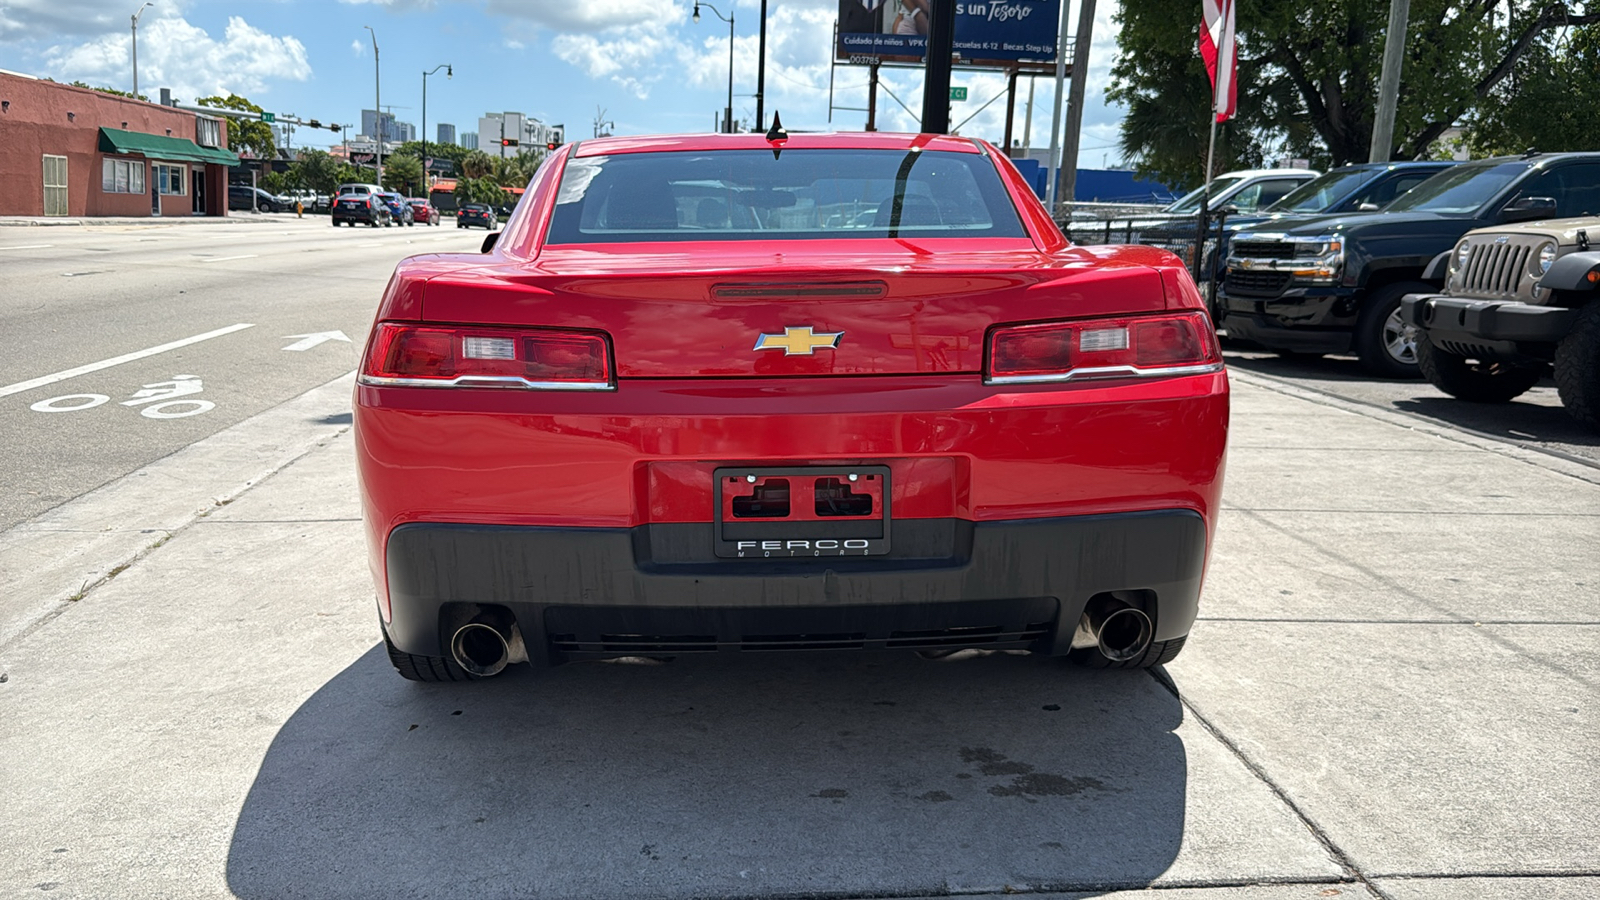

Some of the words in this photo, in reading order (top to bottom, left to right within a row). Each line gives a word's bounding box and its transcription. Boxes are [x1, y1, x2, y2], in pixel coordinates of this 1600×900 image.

[968, 4, 986, 16] un
[987, 0, 1033, 21] Tesoro
[844, 37, 873, 45] Cuidado
[884, 38, 904, 46] niños
[1003, 43, 1024, 51] Becas
[1025, 44, 1041, 53] Step
[1042, 46, 1053, 54] Up
[850, 55, 880, 65] 003785
[737, 539, 869, 550] FERCO
